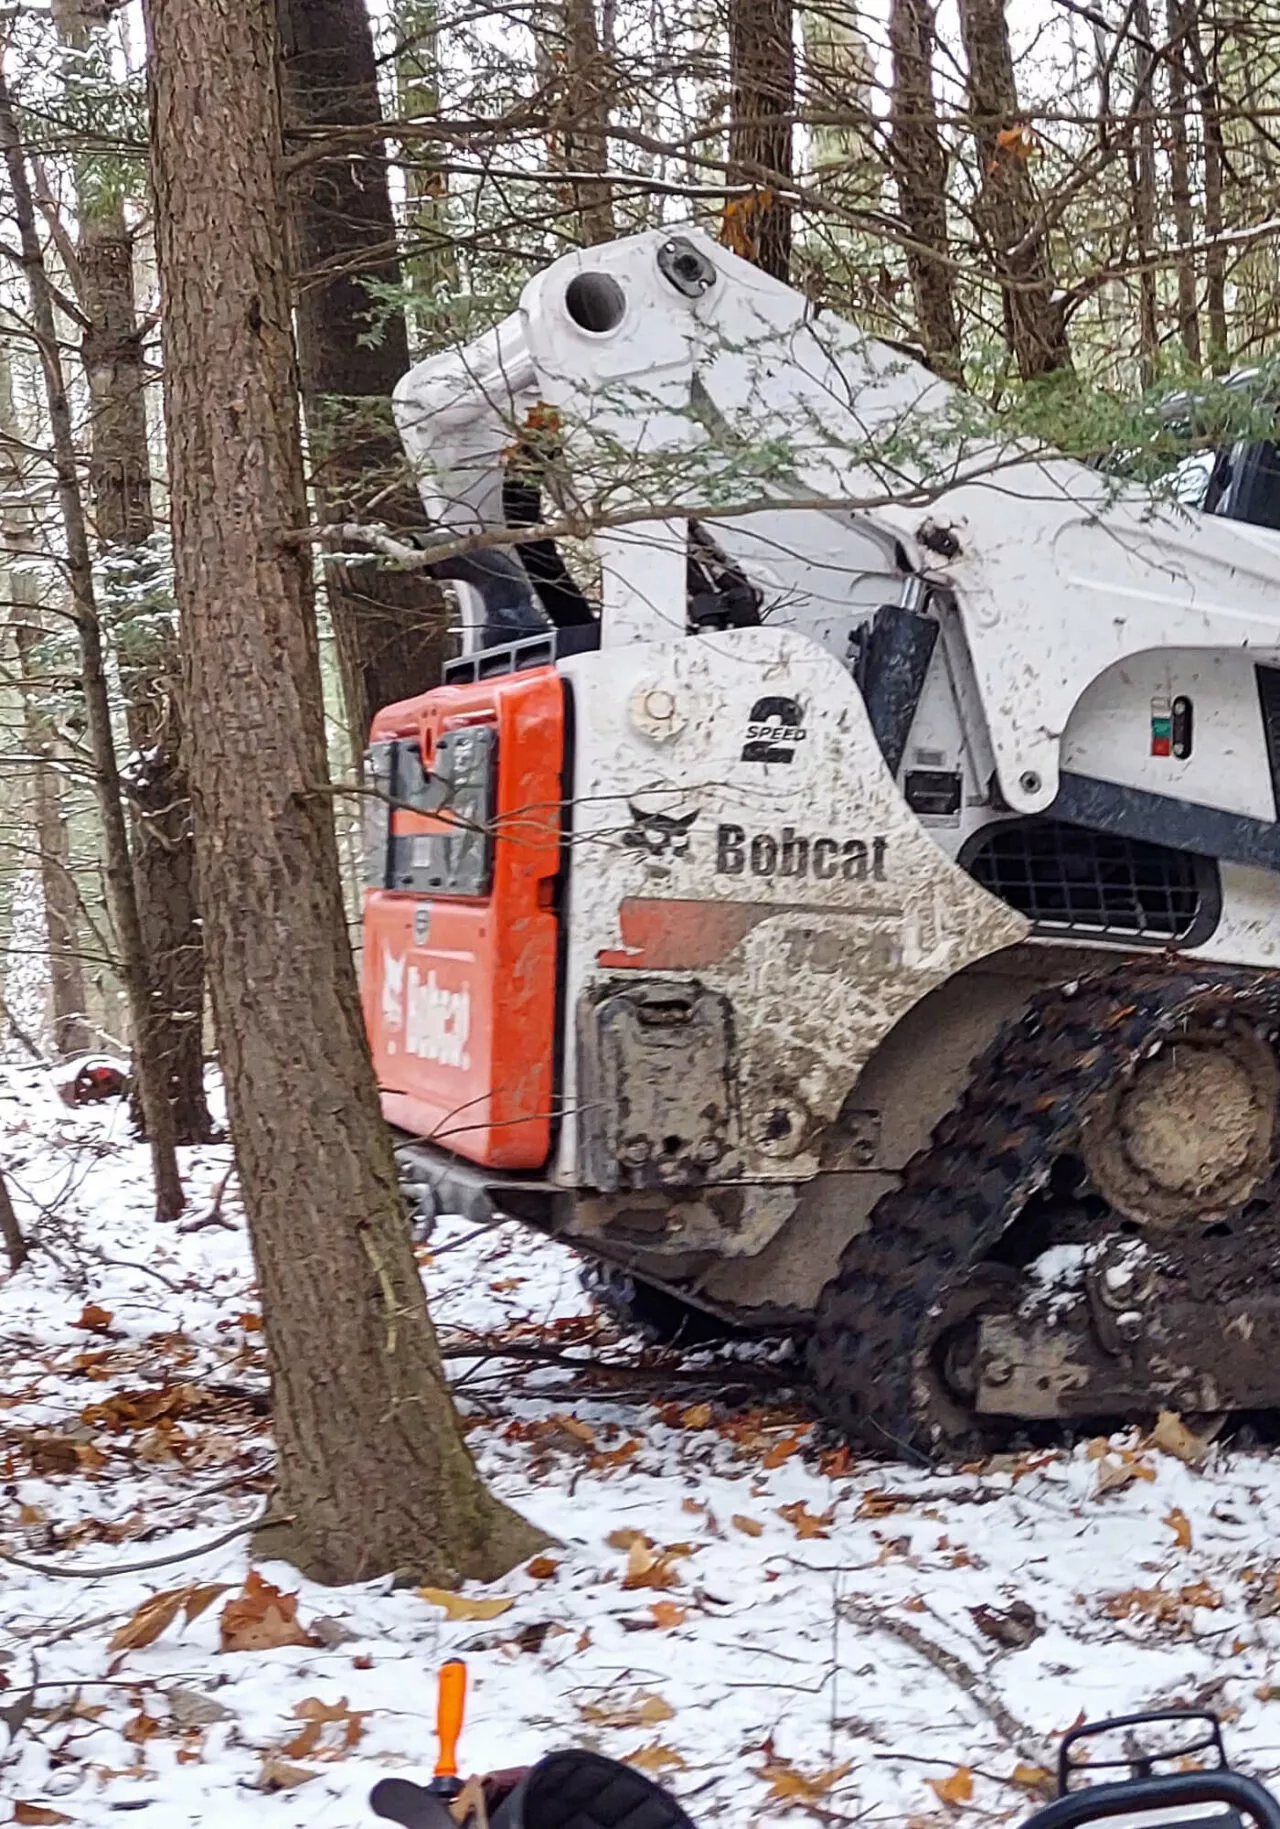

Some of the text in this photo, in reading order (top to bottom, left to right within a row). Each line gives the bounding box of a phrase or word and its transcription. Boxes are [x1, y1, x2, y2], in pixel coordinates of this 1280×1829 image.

[741, 696, 804, 763] 2
[746, 726, 807, 741] SPEED
[717, 823, 887, 882] Bobcat
